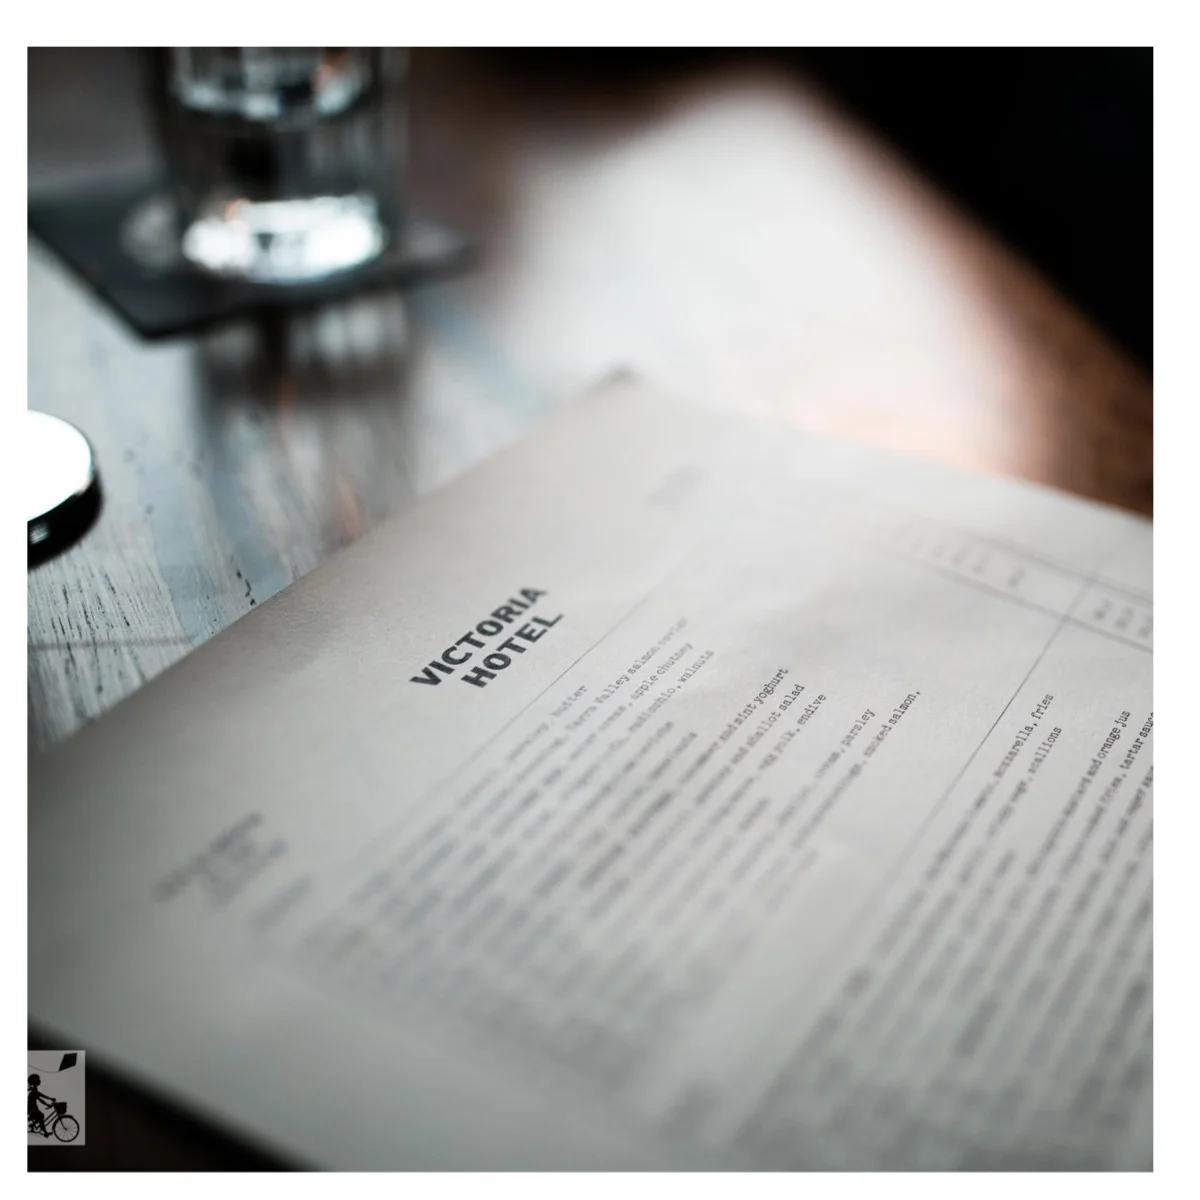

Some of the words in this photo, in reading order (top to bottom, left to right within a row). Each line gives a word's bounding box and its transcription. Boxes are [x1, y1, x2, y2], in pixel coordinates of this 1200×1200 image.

[409, 588, 547, 686] VICTORIA
[460, 614, 564, 688] HOTEL
[593, 674, 631, 704] Valley
[627, 645, 660, 675] salmon
[734, 703, 758, 727] mint
[753, 667, 789, 706] yoghurt
[778, 683, 806, 713] salad
[796, 693, 828, 727] endive
[1030, 693, 1055, 721] fries
[840, 708, 876, 748] parsley
[1097, 726, 1122, 760] orange
[1114, 710, 1131, 729] jus
[1118, 737, 1144, 771] tartar
